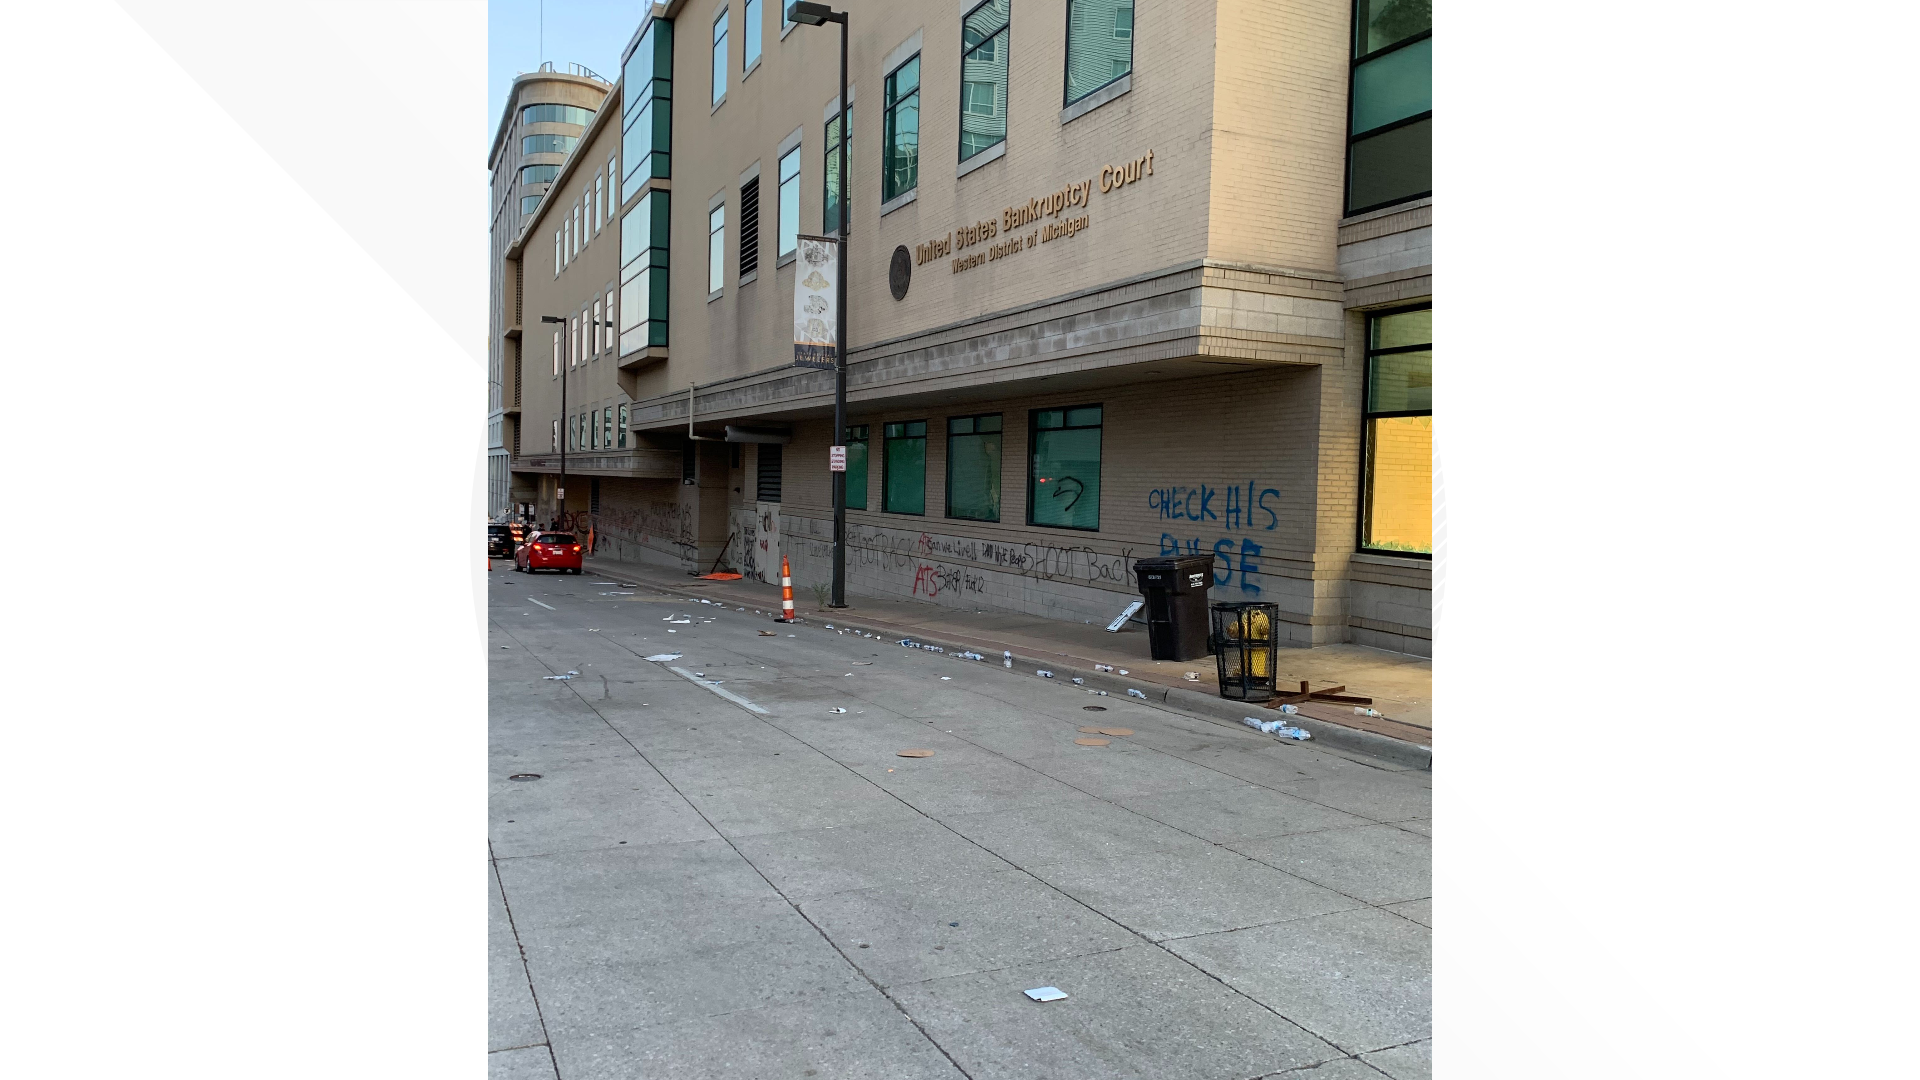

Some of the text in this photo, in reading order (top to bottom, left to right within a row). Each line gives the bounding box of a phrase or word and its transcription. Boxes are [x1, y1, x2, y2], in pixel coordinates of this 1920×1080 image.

[915, 148, 1154, 265] United States Bankruptcy Court
[951, 213, 1089, 274] Western District of Michigan
[795, 354, 835, 364] JEWELERS
[1148, 480, 1281, 530] CHECK HIS
[913, 563, 938, 597] ATS
[1021, 539, 1080, 583] SHOOT
